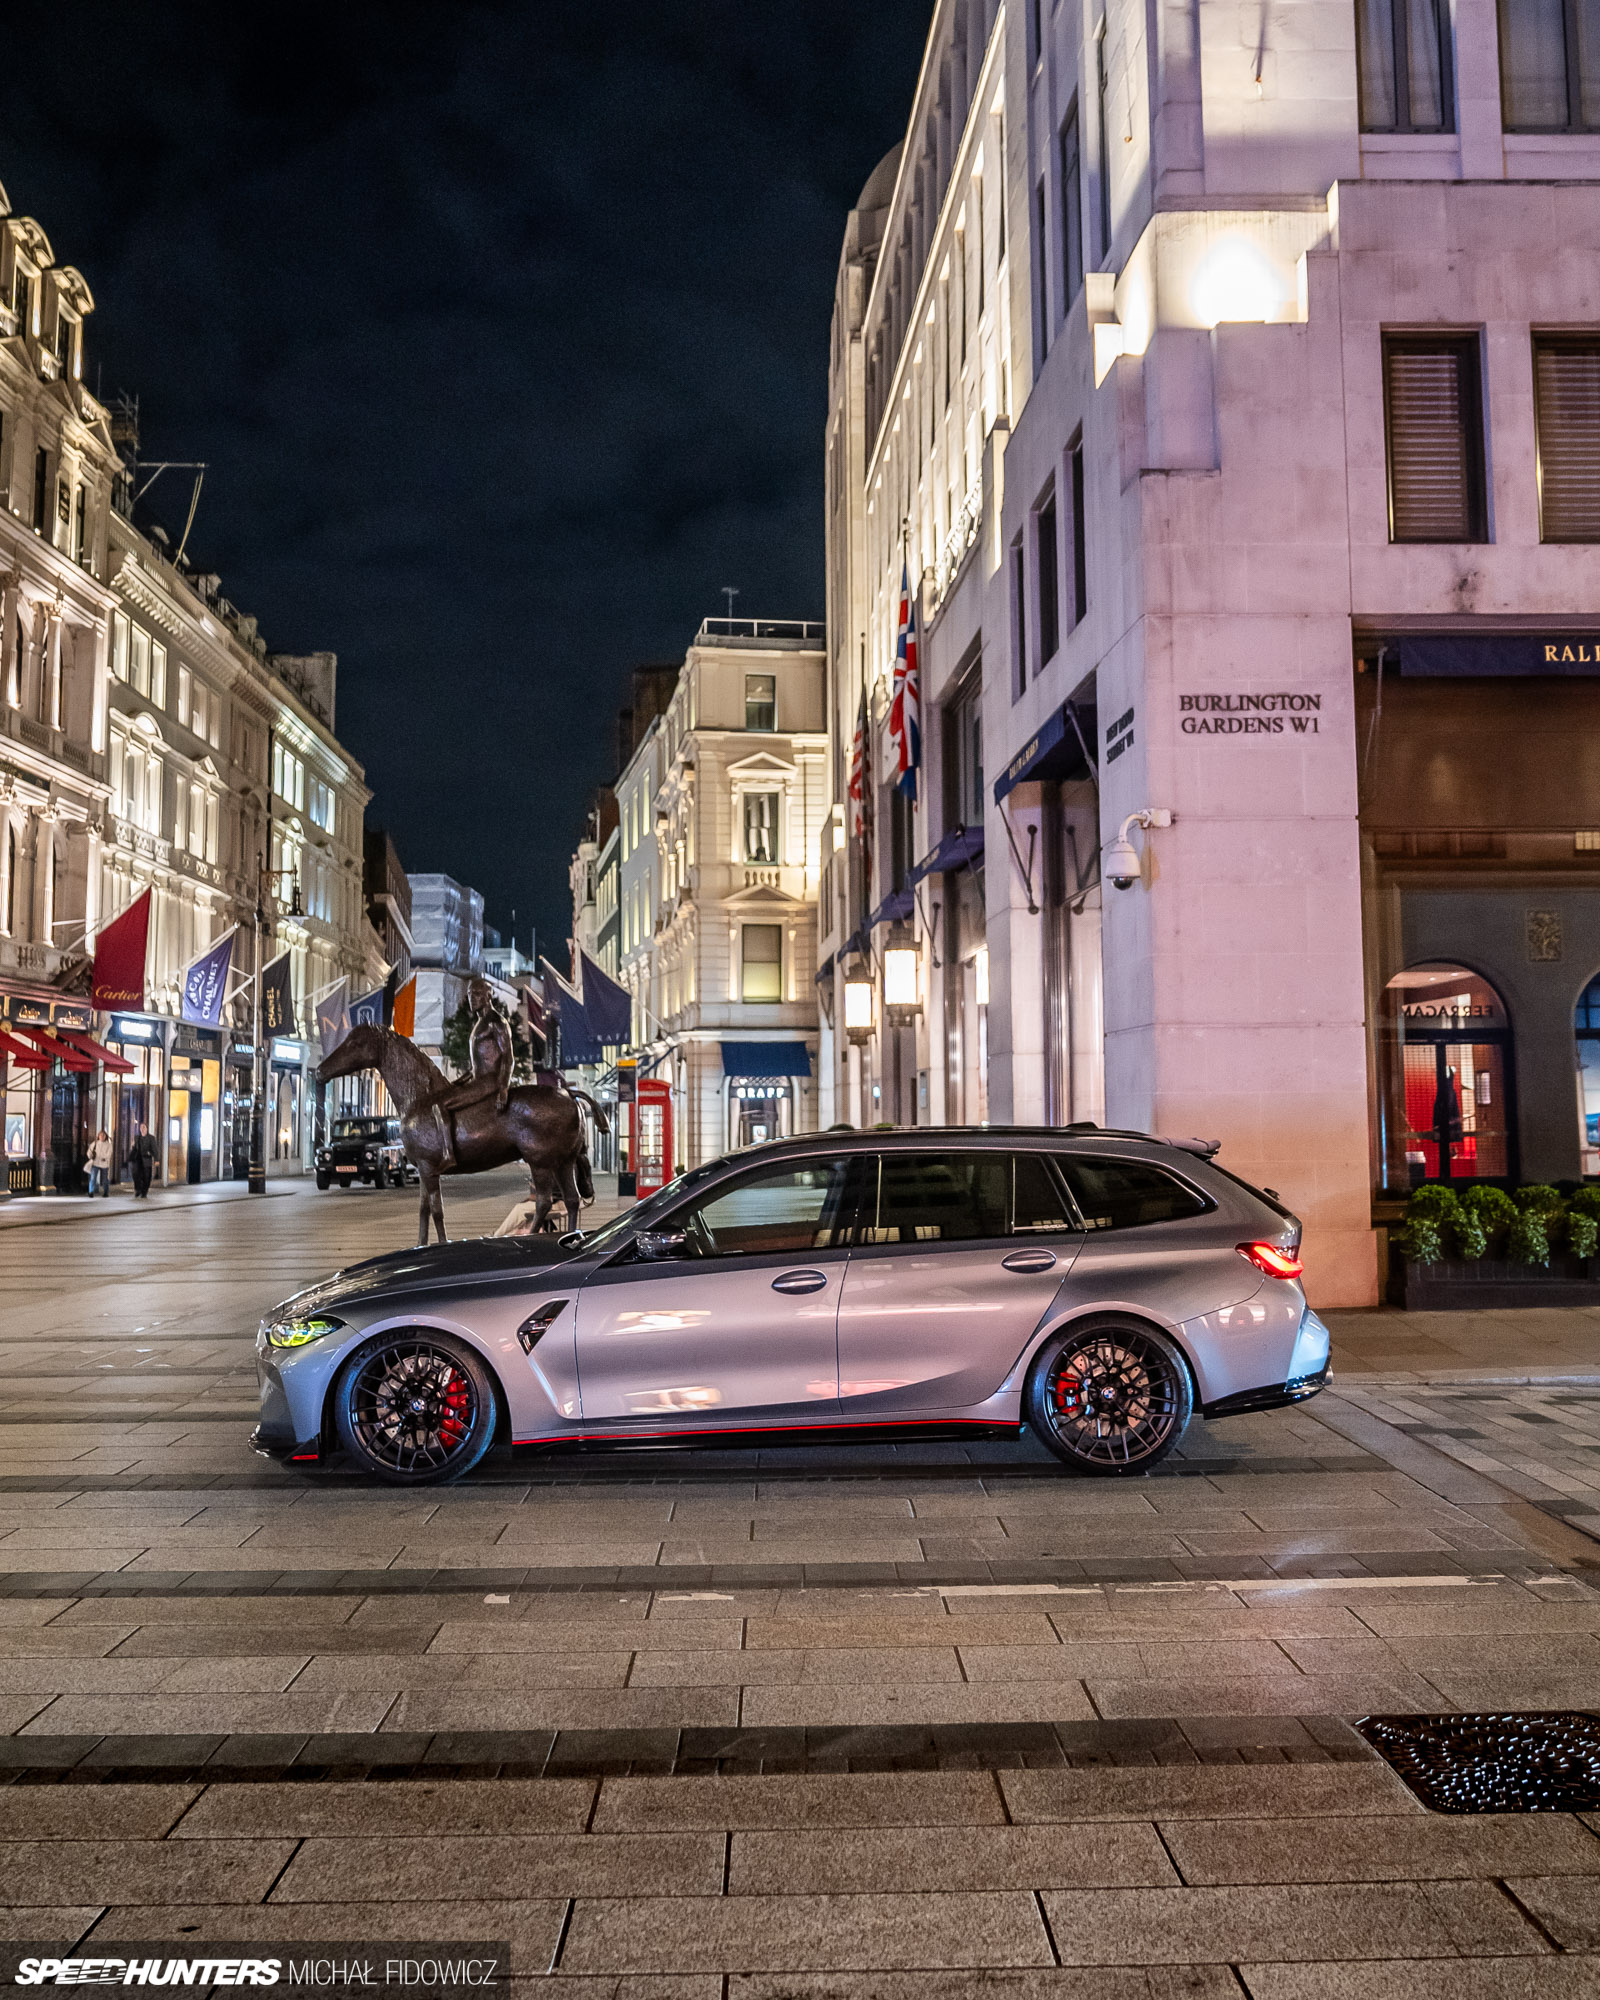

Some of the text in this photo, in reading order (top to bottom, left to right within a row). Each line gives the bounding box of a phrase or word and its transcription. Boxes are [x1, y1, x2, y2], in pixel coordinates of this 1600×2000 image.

[1179, 694, 1321, 712] BURLINGTON
[1181, 717, 1320, 734] GARDENS W1
[95, 985, 142, 1000] Cartier
[202, 961, 219, 1020] CHAUMET
[266, 986, 277, 1029] CHANEL
[736, 1087, 785, 1098] GRAFF
